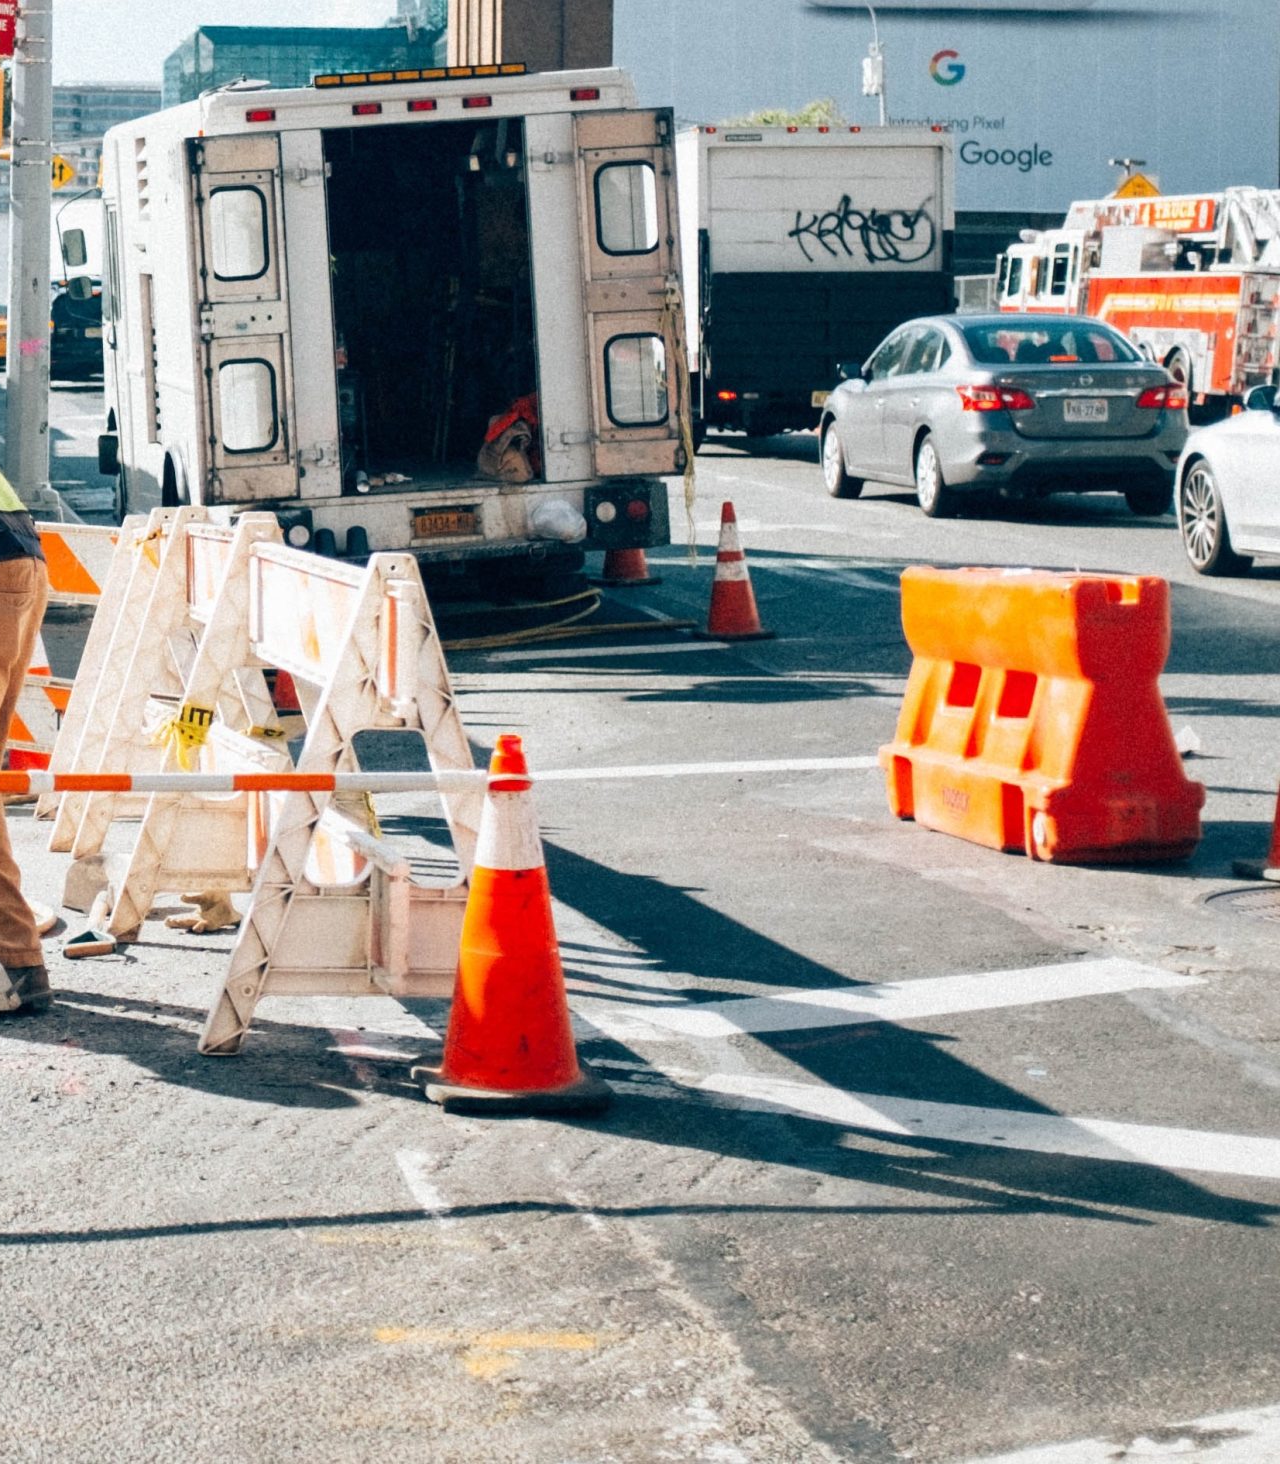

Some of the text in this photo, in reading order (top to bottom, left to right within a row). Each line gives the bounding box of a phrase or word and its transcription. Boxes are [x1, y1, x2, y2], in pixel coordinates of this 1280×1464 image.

[929, 49, 966, 87] G
[888, 116, 1006, 132] Introducing Pixel
[960, 140, 1054, 173] Google
[1154, 201, 1196, 219] TRUCK
